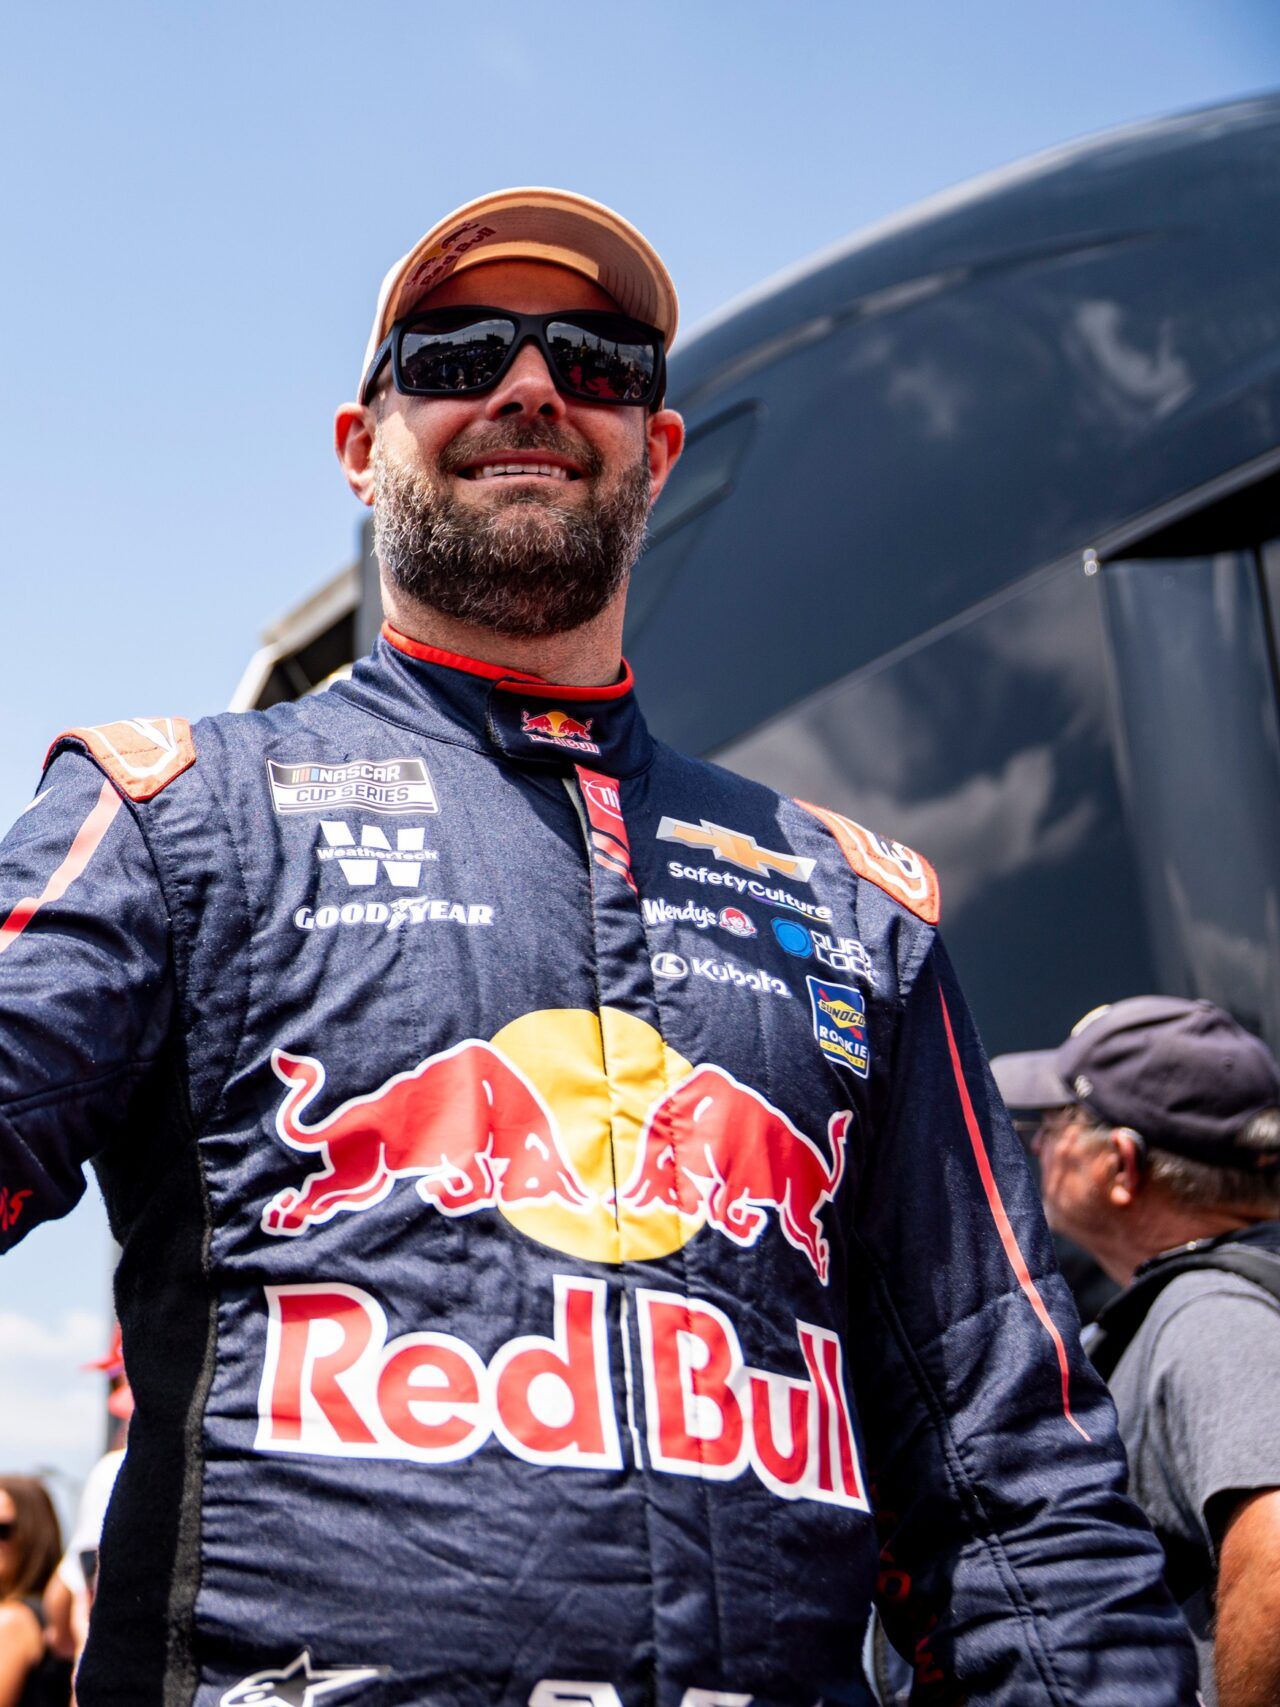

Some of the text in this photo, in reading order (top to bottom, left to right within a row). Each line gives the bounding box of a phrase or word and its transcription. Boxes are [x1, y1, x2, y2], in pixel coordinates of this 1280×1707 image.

[319, 764, 401, 783] NASCAR
[296, 784, 409, 802] CUP SERIES
[317, 847, 439, 861] WeatherTech
[669, 861, 832, 920] SafetyCulture
[642, 898, 718, 929] Wendy's
[691, 957, 792, 998] Kubota
[820, 1000, 867, 1027] SUNOCO
[256, 1276, 869, 1512] Red Bull
